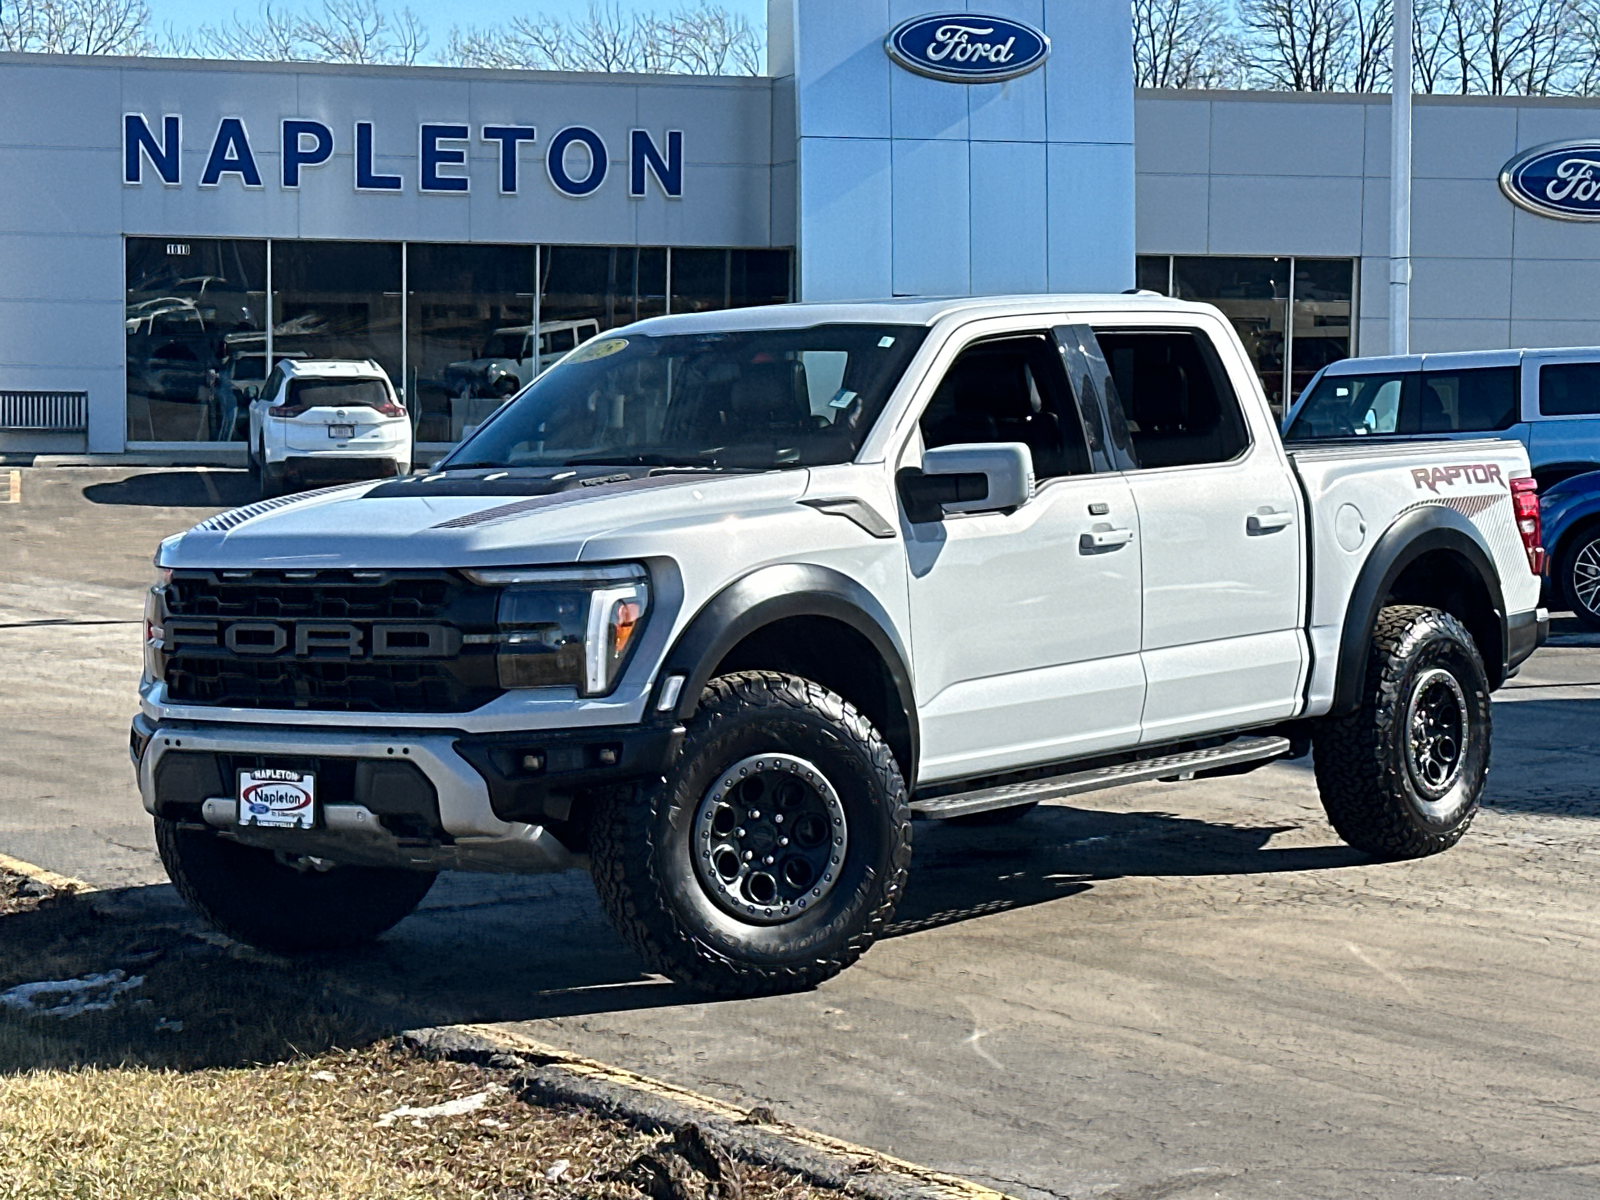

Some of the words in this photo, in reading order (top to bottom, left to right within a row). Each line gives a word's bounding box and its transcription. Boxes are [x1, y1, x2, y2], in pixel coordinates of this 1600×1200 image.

[927, 25, 1016, 63] Ford
[122, 112, 684, 199] NAPLETON
[1546, 158, 1600, 201] Fo
[1410, 464, 1508, 495] RAPTOR
[163, 621, 464, 657] FORD
[254, 769, 299, 780] NAPLETON
[254, 788, 301, 805] Napleton
